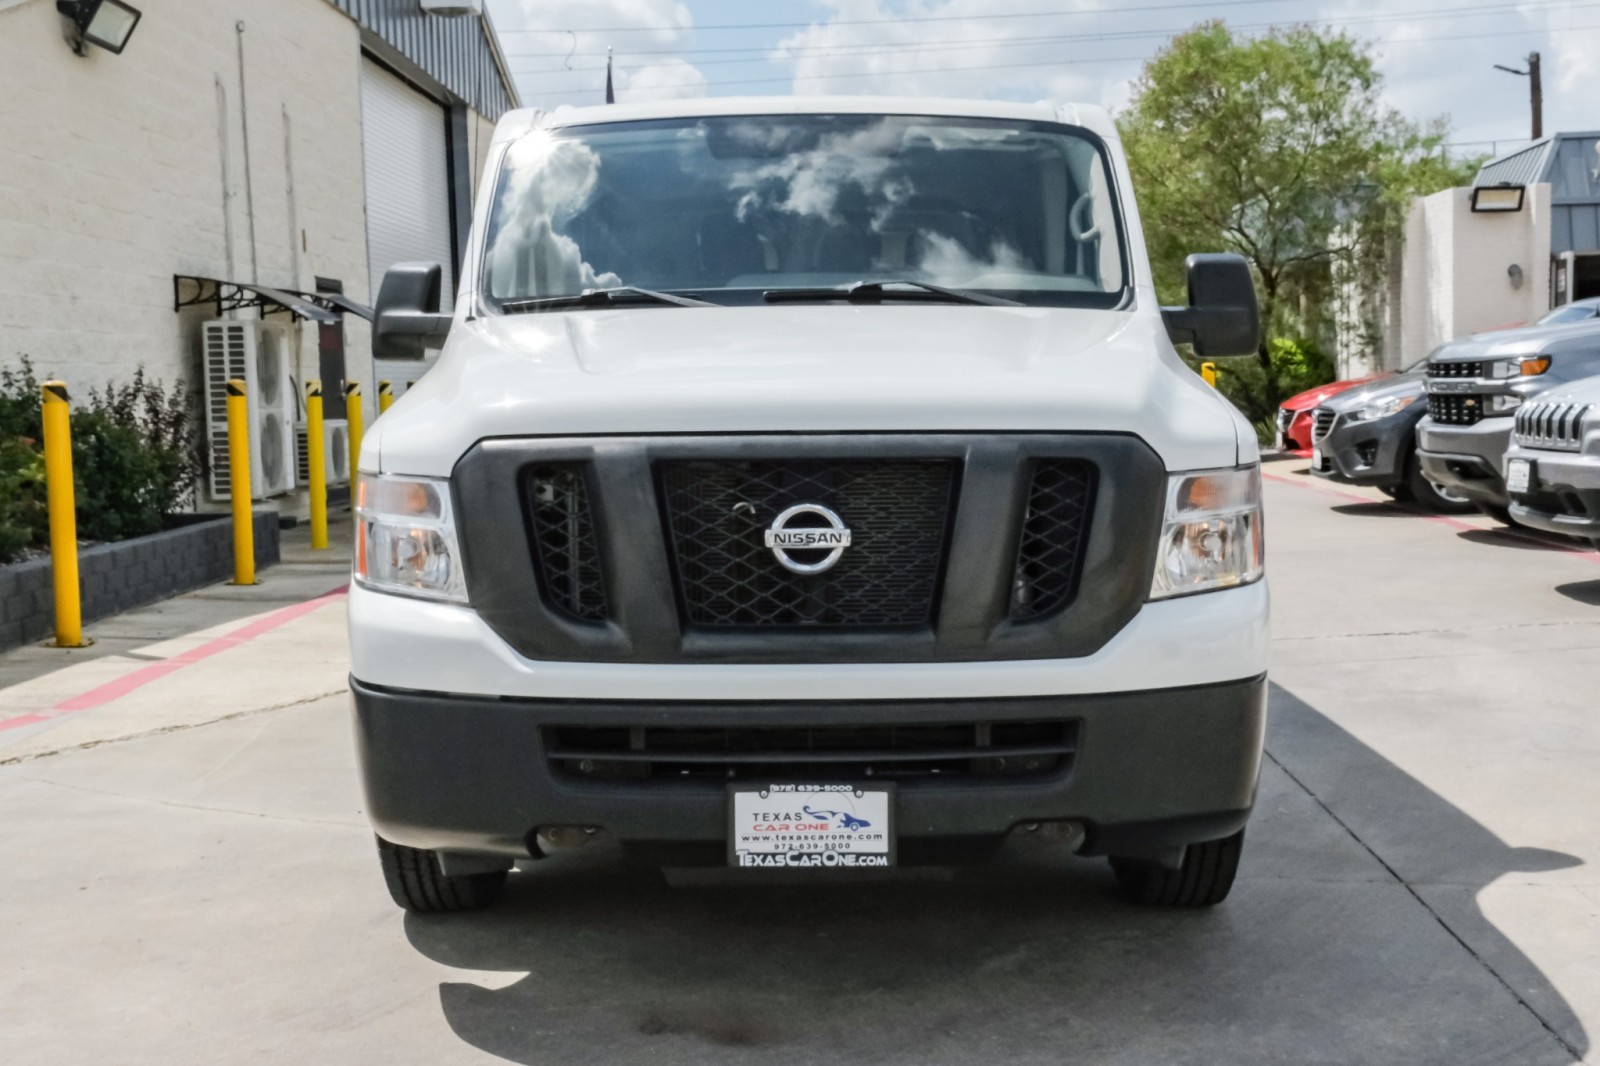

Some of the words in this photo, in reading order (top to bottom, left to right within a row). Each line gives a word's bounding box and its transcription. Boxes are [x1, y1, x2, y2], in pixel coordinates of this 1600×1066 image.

[774, 532, 842, 544] NISSAN
[769, 784, 796, 793] (972)
[797, 784, 853, 792] 639-5000
[752, 812, 803, 822] TEXAS
[753, 823, 790, 832] CAR
[795, 823, 830, 831] ONE
[741, 833, 883, 842] www.texascarone.com
